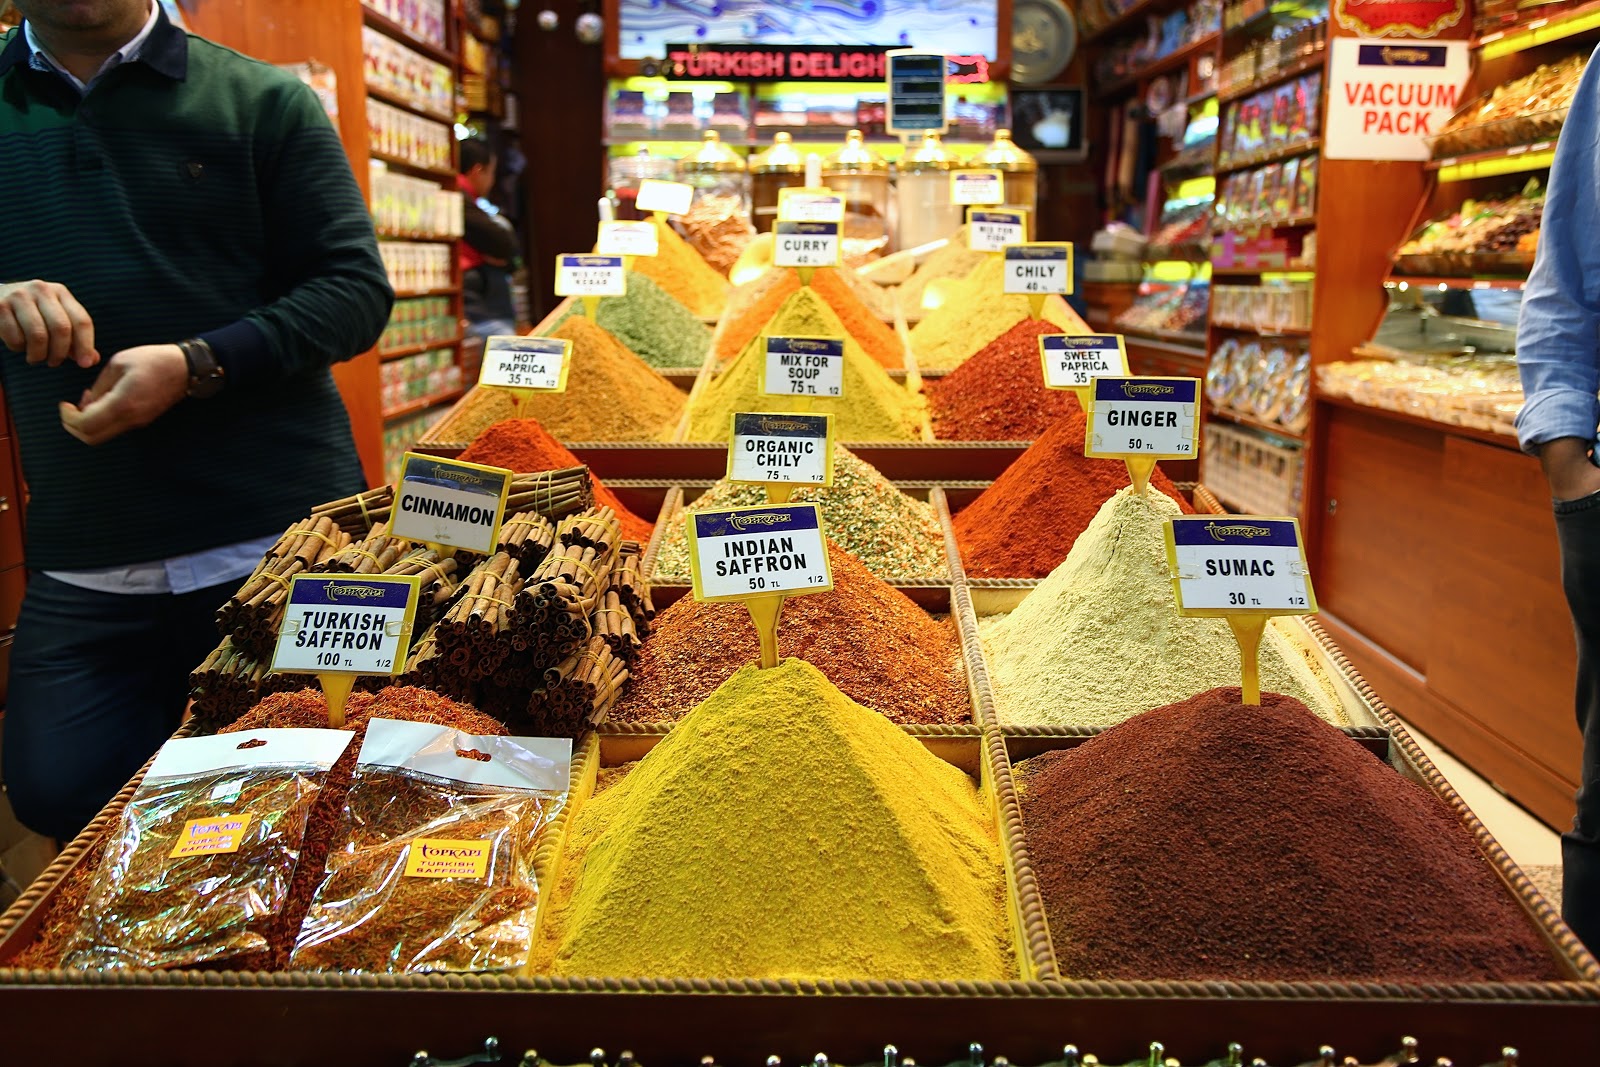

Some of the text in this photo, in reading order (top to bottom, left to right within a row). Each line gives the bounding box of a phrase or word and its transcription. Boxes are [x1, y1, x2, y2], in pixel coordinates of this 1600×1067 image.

[669, 51, 886, 78] TURKISH DELIGH
[1345, 82, 1457, 108] VACUUM
[1363, 110, 1431, 135] PACK
[784, 239, 828, 251] CURRY
[1016, 266, 1056, 278] CHILY
[1026, 282, 1038, 291] 40
[513, 353, 536, 363] HOT
[780, 354, 829, 368] MIX FOR
[1064, 351, 1101, 361] SWEET
[499, 362, 546, 374] PAPRICA
[788, 367, 820, 379] SOUP
[1061, 361, 1109, 371] PAPRICA
[508, 373, 521, 384] 35
[525, 377, 533, 385] TL
[1074, 372, 1087, 383] 35
[791, 380, 804, 393] 75
[807, 385, 817, 394] TL
[1107, 409, 1178, 428] GINGER
[745, 439, 814, 454] ORGANIC
[1128, 438, 1142, 450] 50
[1176, 443, 1190, 451] 1/2
[756, 454, 801, 467] CHILY
[767, 470, 779, 480] 75
[401, 494, 495, 527] CINNAMON
[724, 536, 794, 558] INDIAN
[715, 553, 807, 577] SAFFRON
[1205, 558, 1275, 577] SUMAC
[749, 577, 766, 590] 50
[807, 575, 824, 584] 1/2
[1228, 592, 1246, 605] 30
[1288, 597, 1305, 605] 1/2
[302, 611, 387, 632] TURKISH
[295, 630, 384, 651] SAFFRON
[316, 652, 341, 666] 100
[375, 659, 391, 668] 1/2
